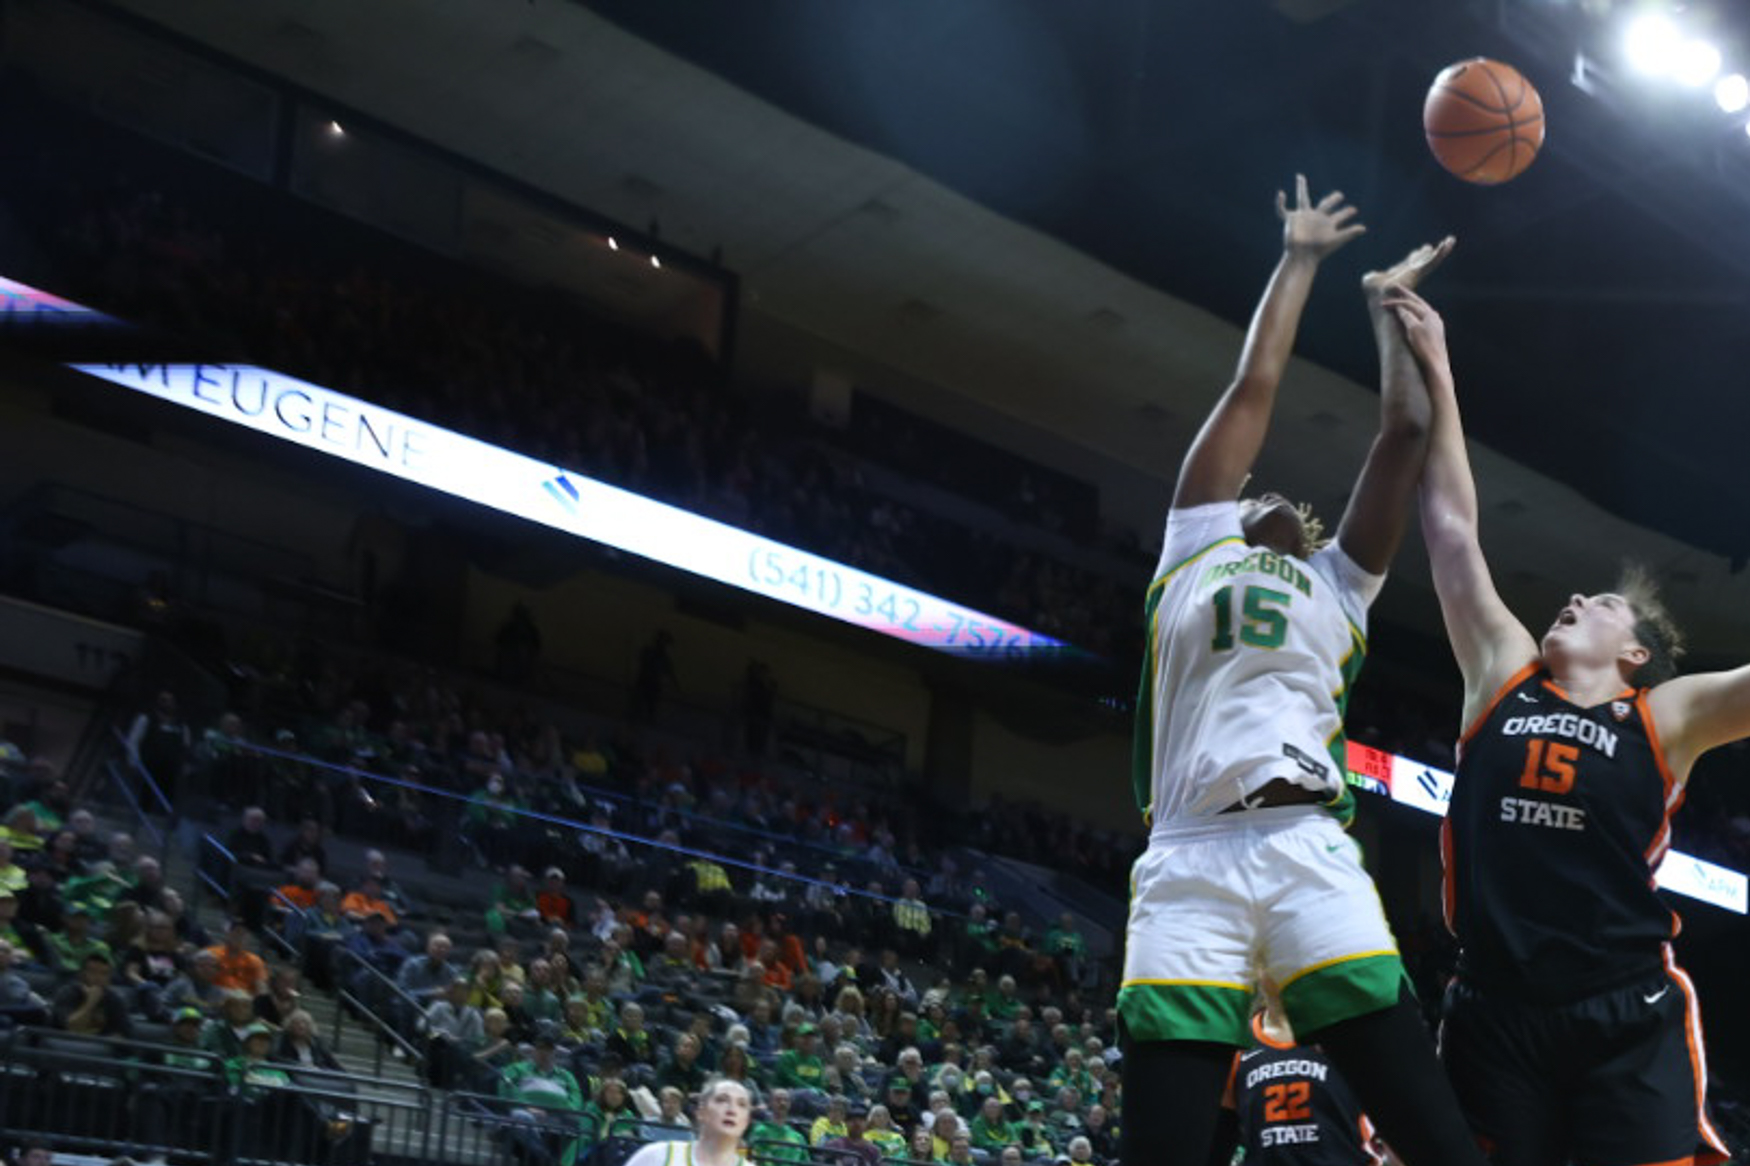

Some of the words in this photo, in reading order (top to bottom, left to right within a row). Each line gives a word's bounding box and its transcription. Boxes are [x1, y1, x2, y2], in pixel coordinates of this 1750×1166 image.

[192, 365, 430, 468] EUGENE
[746, 546, 842, 609] (541)
[854, 581, 922, 633] 342
[1203, 550, 1312, 598] OREGON
[1211, 585, 1291, 652] 15
[1502, 712, 1619, 758] OREGON
[1519, 737, 1580, 795] 15
[1499, 797, 1585, 831] STATE
[1246, 1060, 1328, 1089] OREGON
[1265, 1081, 1311, 1123] 22
[1261, 1124, 1319, 1148] STATE
